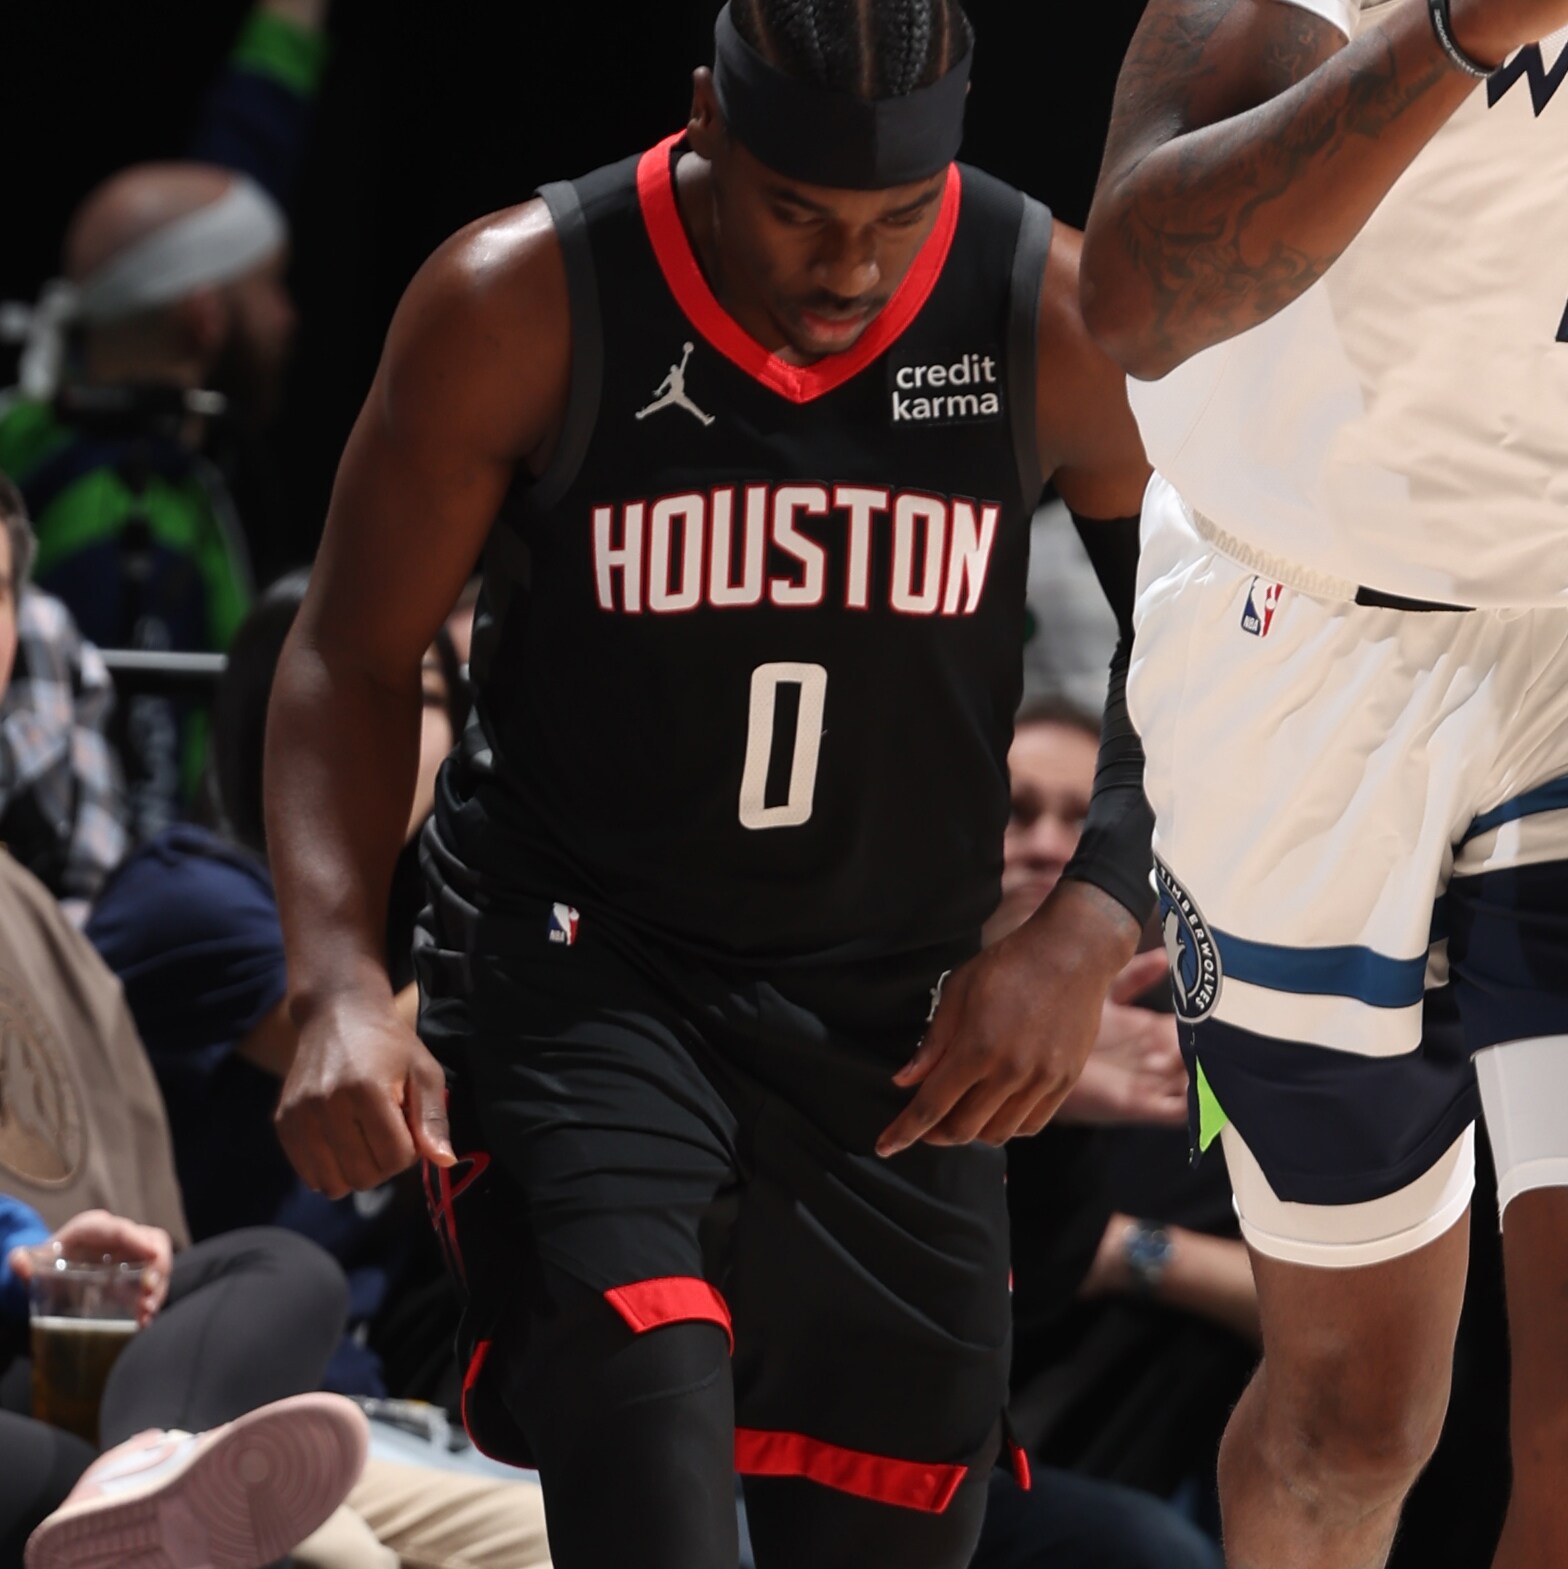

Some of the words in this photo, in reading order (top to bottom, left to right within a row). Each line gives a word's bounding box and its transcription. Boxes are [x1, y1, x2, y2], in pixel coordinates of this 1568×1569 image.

[892, 391, 999, 421] karma
[897, 353, 996, 389] credit
[591, 484, 1001, 616] HOUSTON
[739, 662, 828, 830] 0
[1160, 867, 1215, 1010] TIMBERWOLVES
